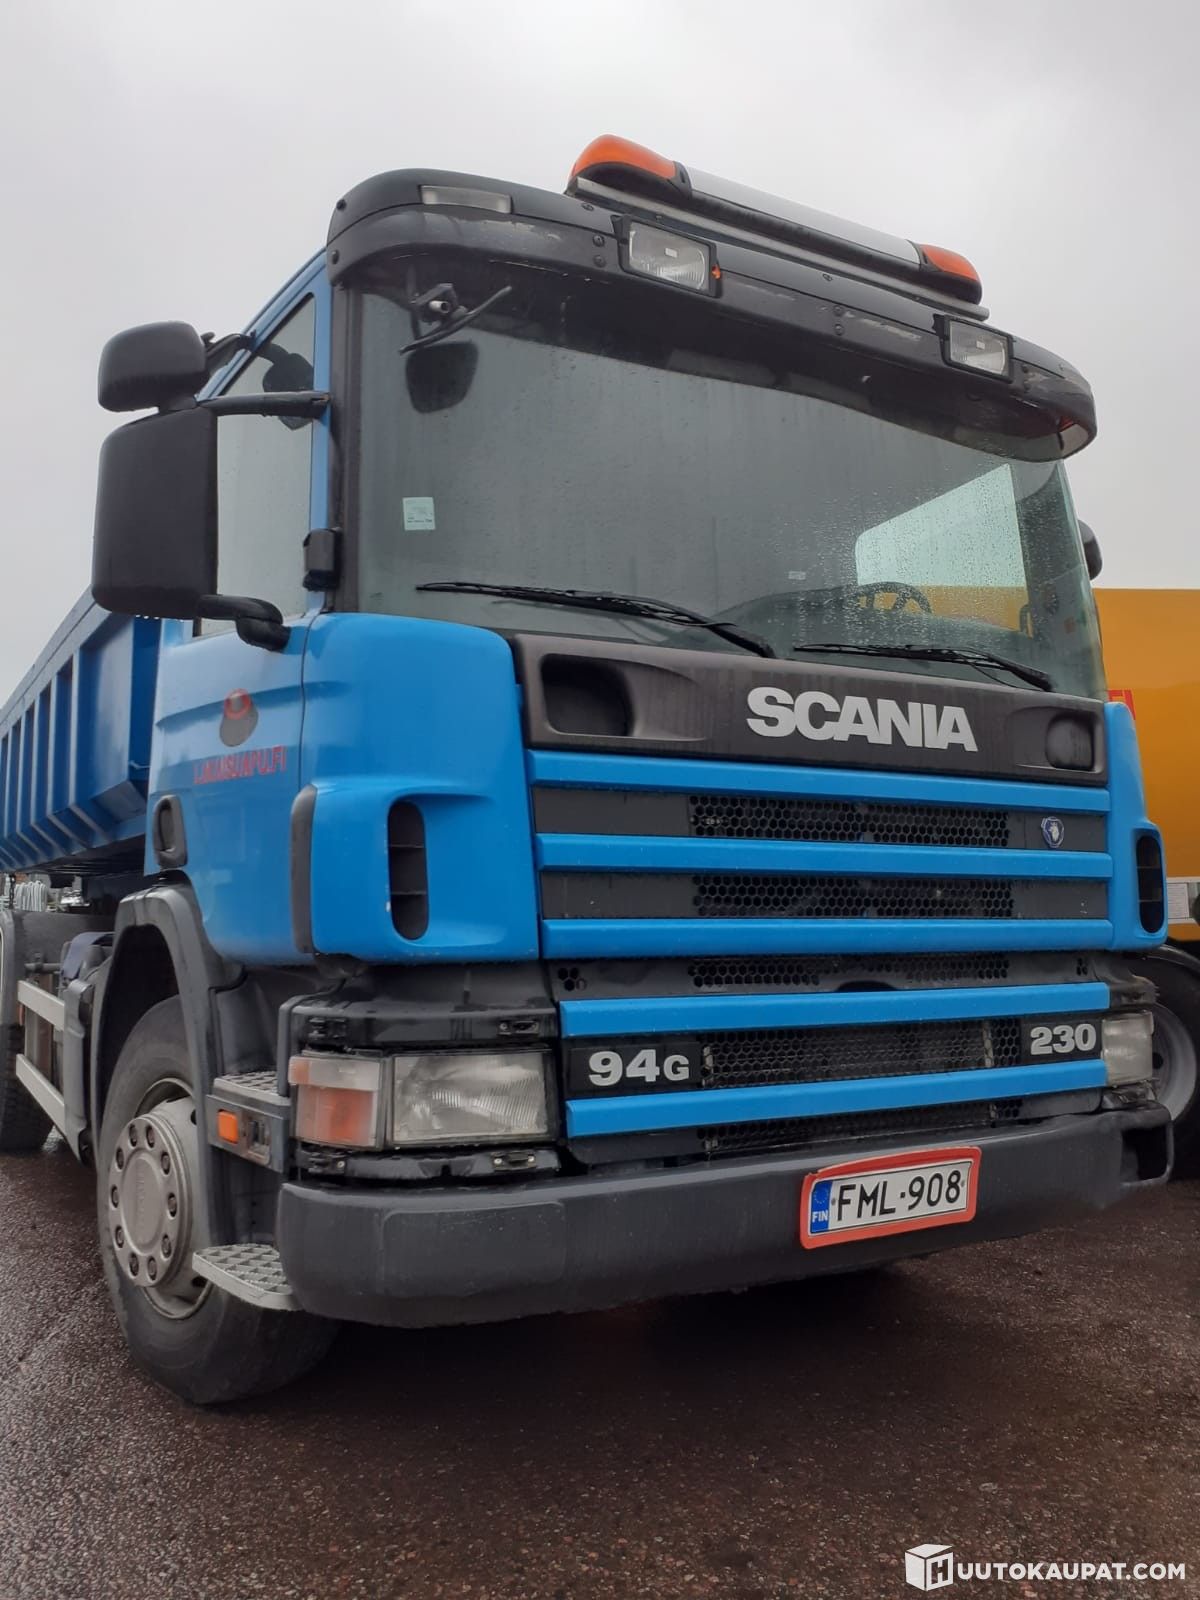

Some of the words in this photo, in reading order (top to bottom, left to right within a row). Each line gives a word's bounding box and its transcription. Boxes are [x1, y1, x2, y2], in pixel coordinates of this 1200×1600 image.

[746, 686, 978, 752] SCANIA
[1030, 1023, 1097, 1055] 230
[588, 1049, 690, 1086] 94G
[836, 1170, 962, 1221] FML-908
[812, 1210, 829, 1223] FIN
